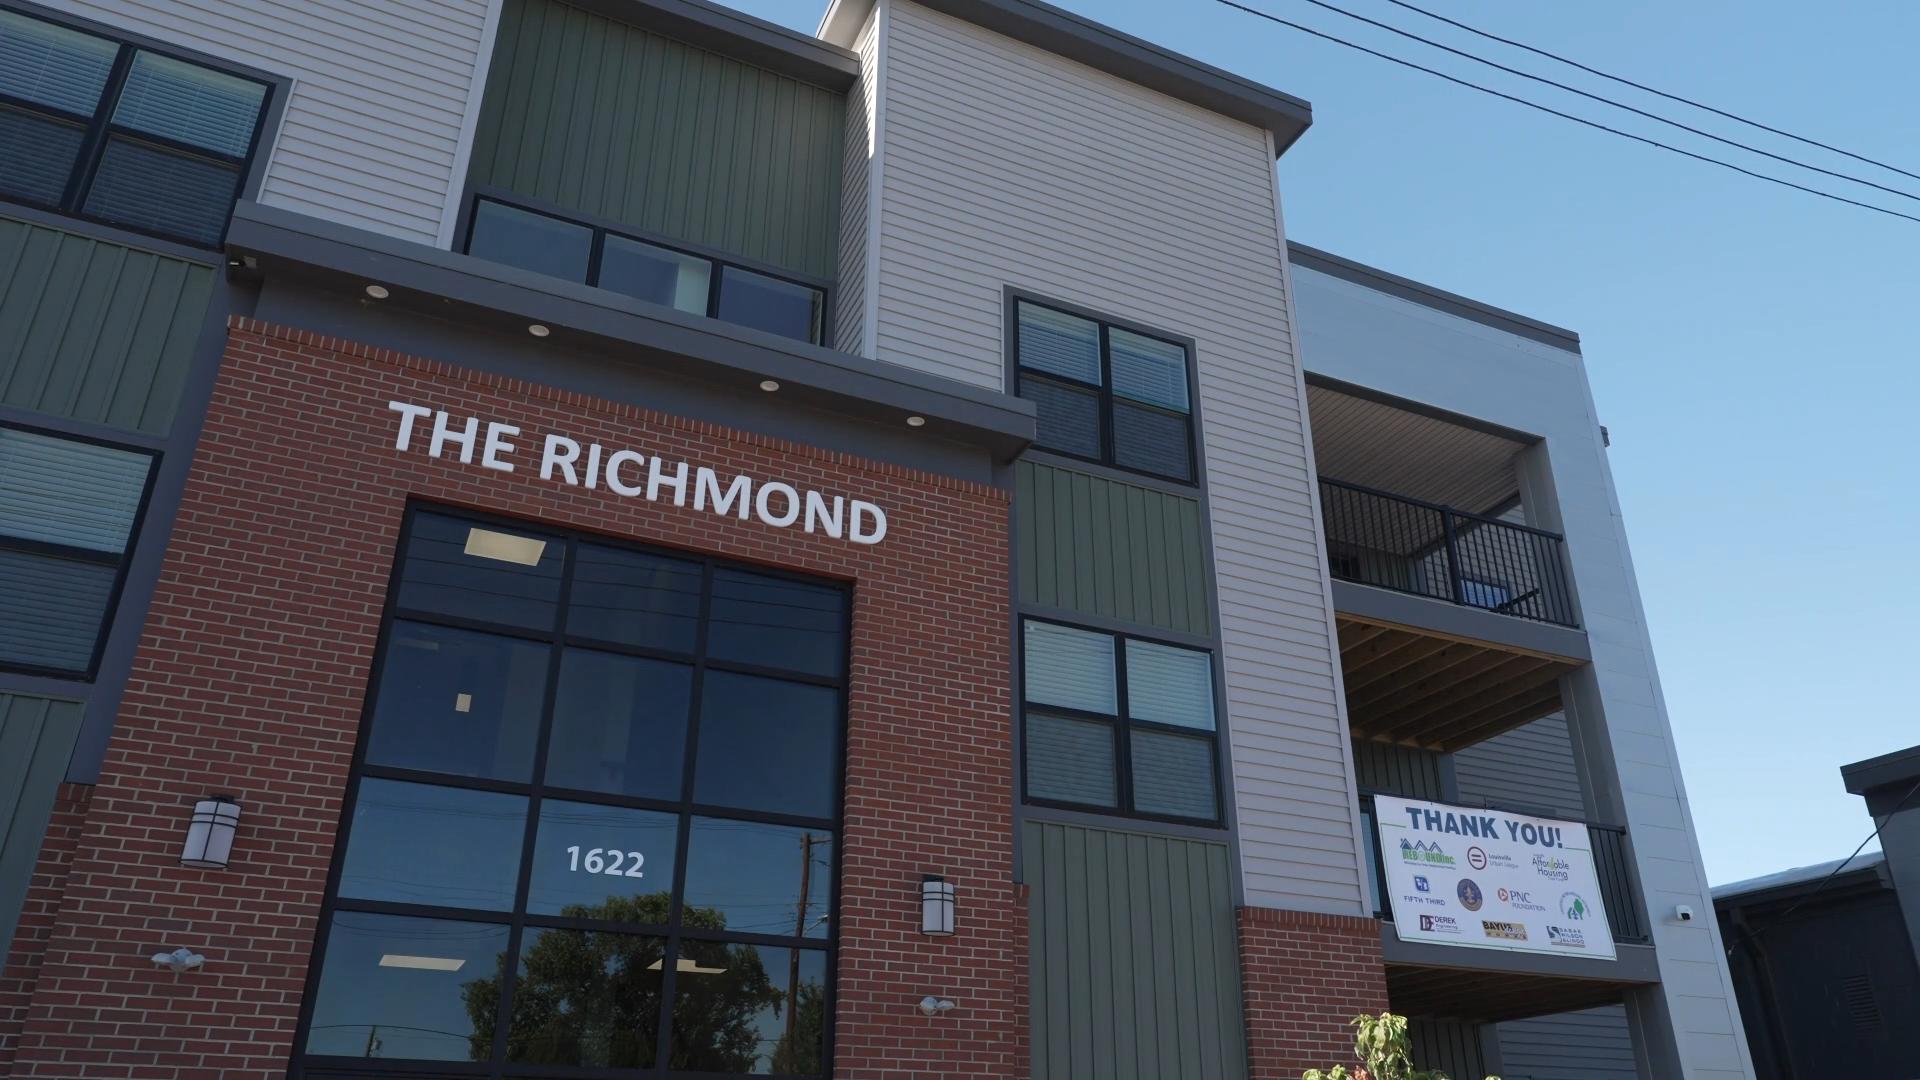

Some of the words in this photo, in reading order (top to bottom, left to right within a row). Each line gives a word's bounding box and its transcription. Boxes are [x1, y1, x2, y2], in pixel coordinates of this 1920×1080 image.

[388, 400, 521, 473] THE
[539, 433, 888, 546] RICHMOND
[1405, 807, 1500, 840] THANK
[1504, 819, 1563, 849] YOU!
[567, 845, 645, 878] 1622
[1537, 866, 1569, 881] Housing
[1403, 895, 1424, 904] FIFTH
[1425, 897, 1446, 907] THIRD
[1509, 889, 1531, 904] PNC
[1434, 915, 1458, 925] DEREK
